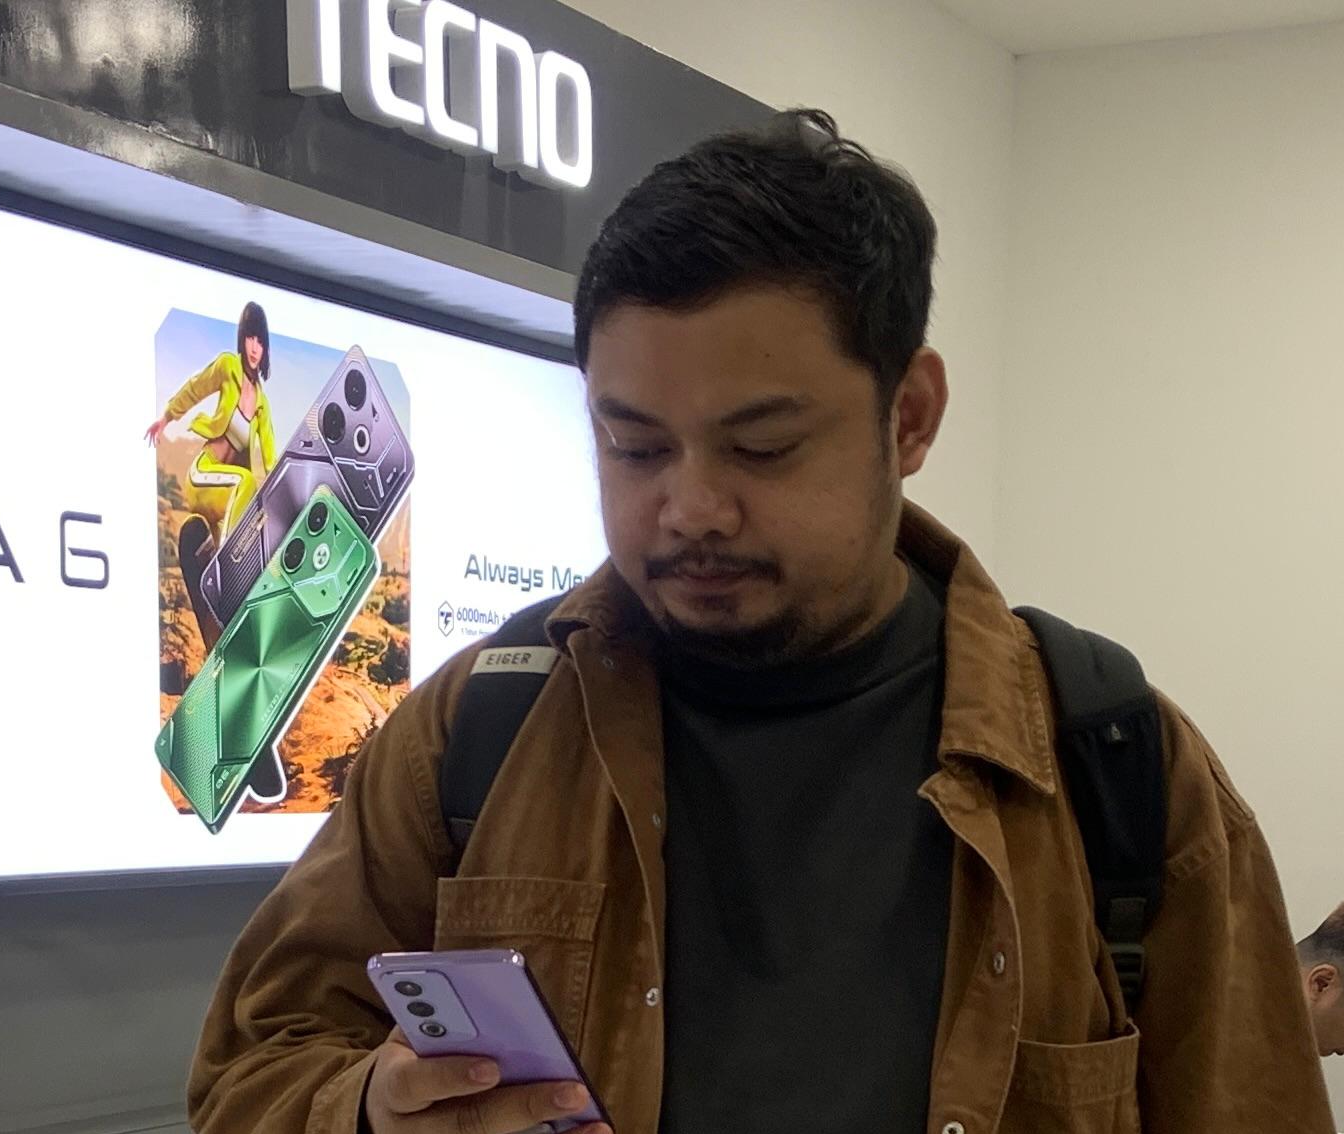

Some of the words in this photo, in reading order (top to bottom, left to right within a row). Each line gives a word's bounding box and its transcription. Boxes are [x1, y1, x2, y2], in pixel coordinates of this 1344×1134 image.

[59, 510, 109, 589] 6
[464, 554, 544, 592] Always
[457, 607, 500, 625] 6000mAh
[486, 652, 532, 665] EIGER
